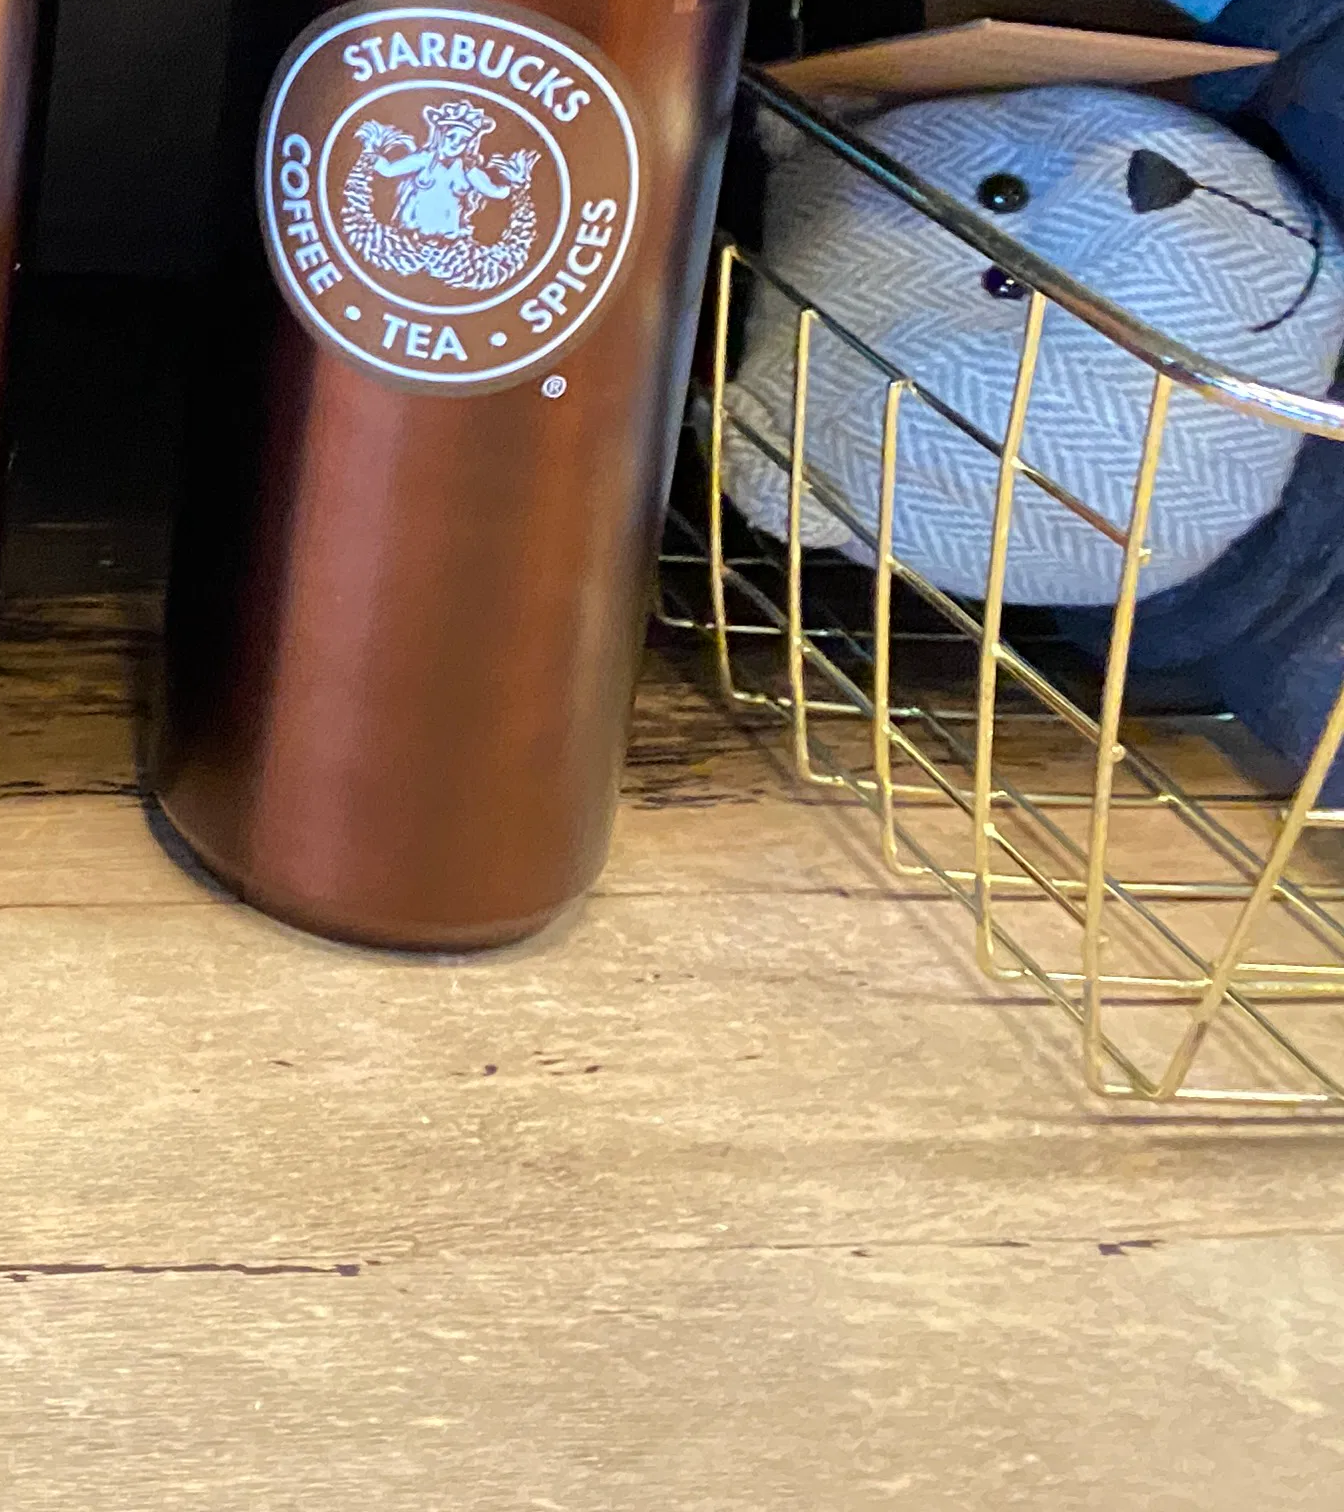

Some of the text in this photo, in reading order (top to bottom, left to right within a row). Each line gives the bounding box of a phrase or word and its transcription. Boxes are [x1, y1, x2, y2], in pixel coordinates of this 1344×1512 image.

[343, 31, 591, 123] STARBUCKS
[279, 132, 618, 362] COFFEE TEA SPICES
